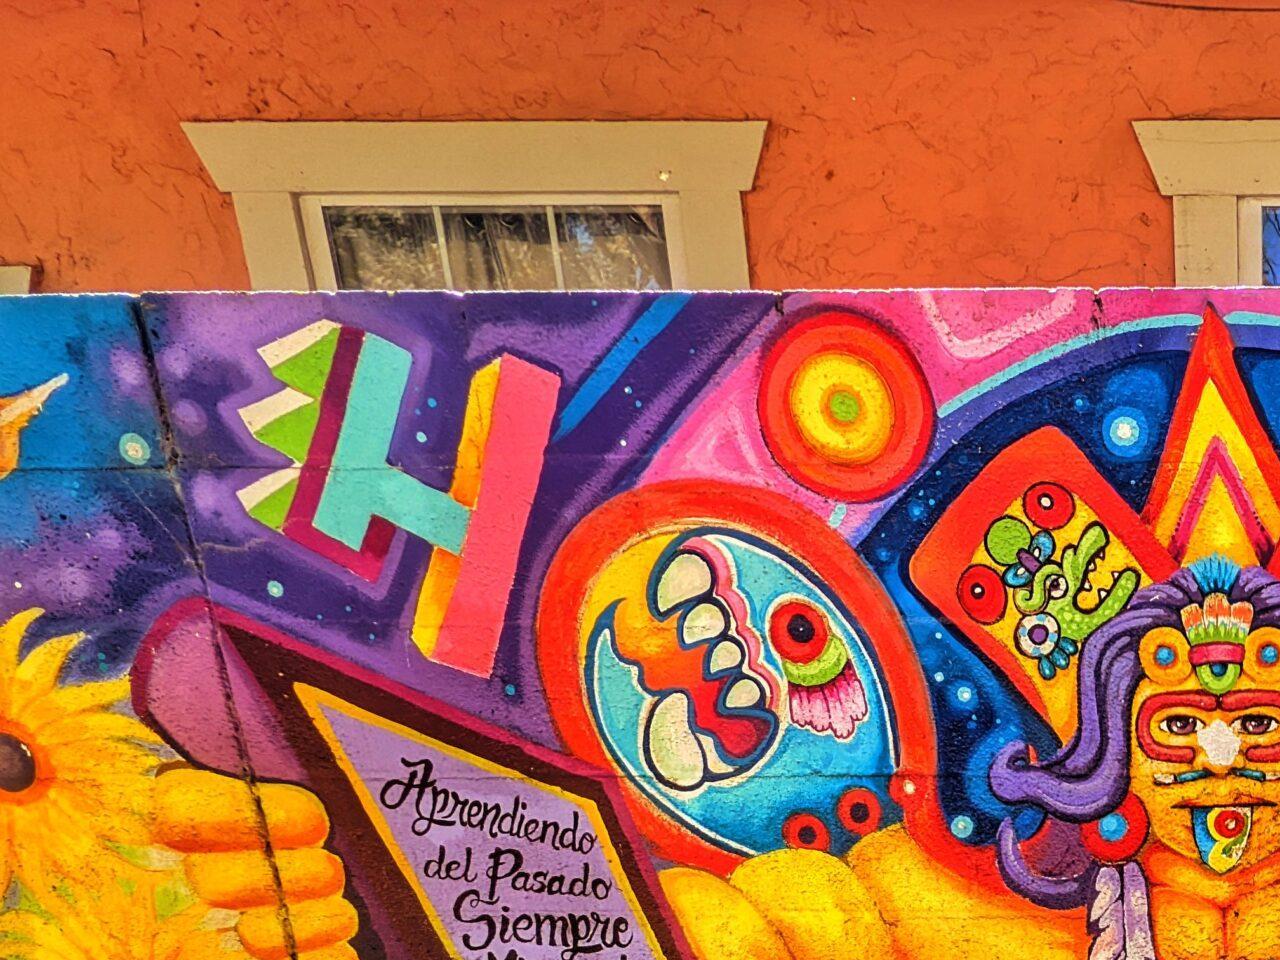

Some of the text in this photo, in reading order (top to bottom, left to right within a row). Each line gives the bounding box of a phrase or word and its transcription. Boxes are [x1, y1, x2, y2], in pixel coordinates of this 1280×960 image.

[380, 757, 598, 855] Aprendiendo
[424, 845, 613, 900] del Pasado
